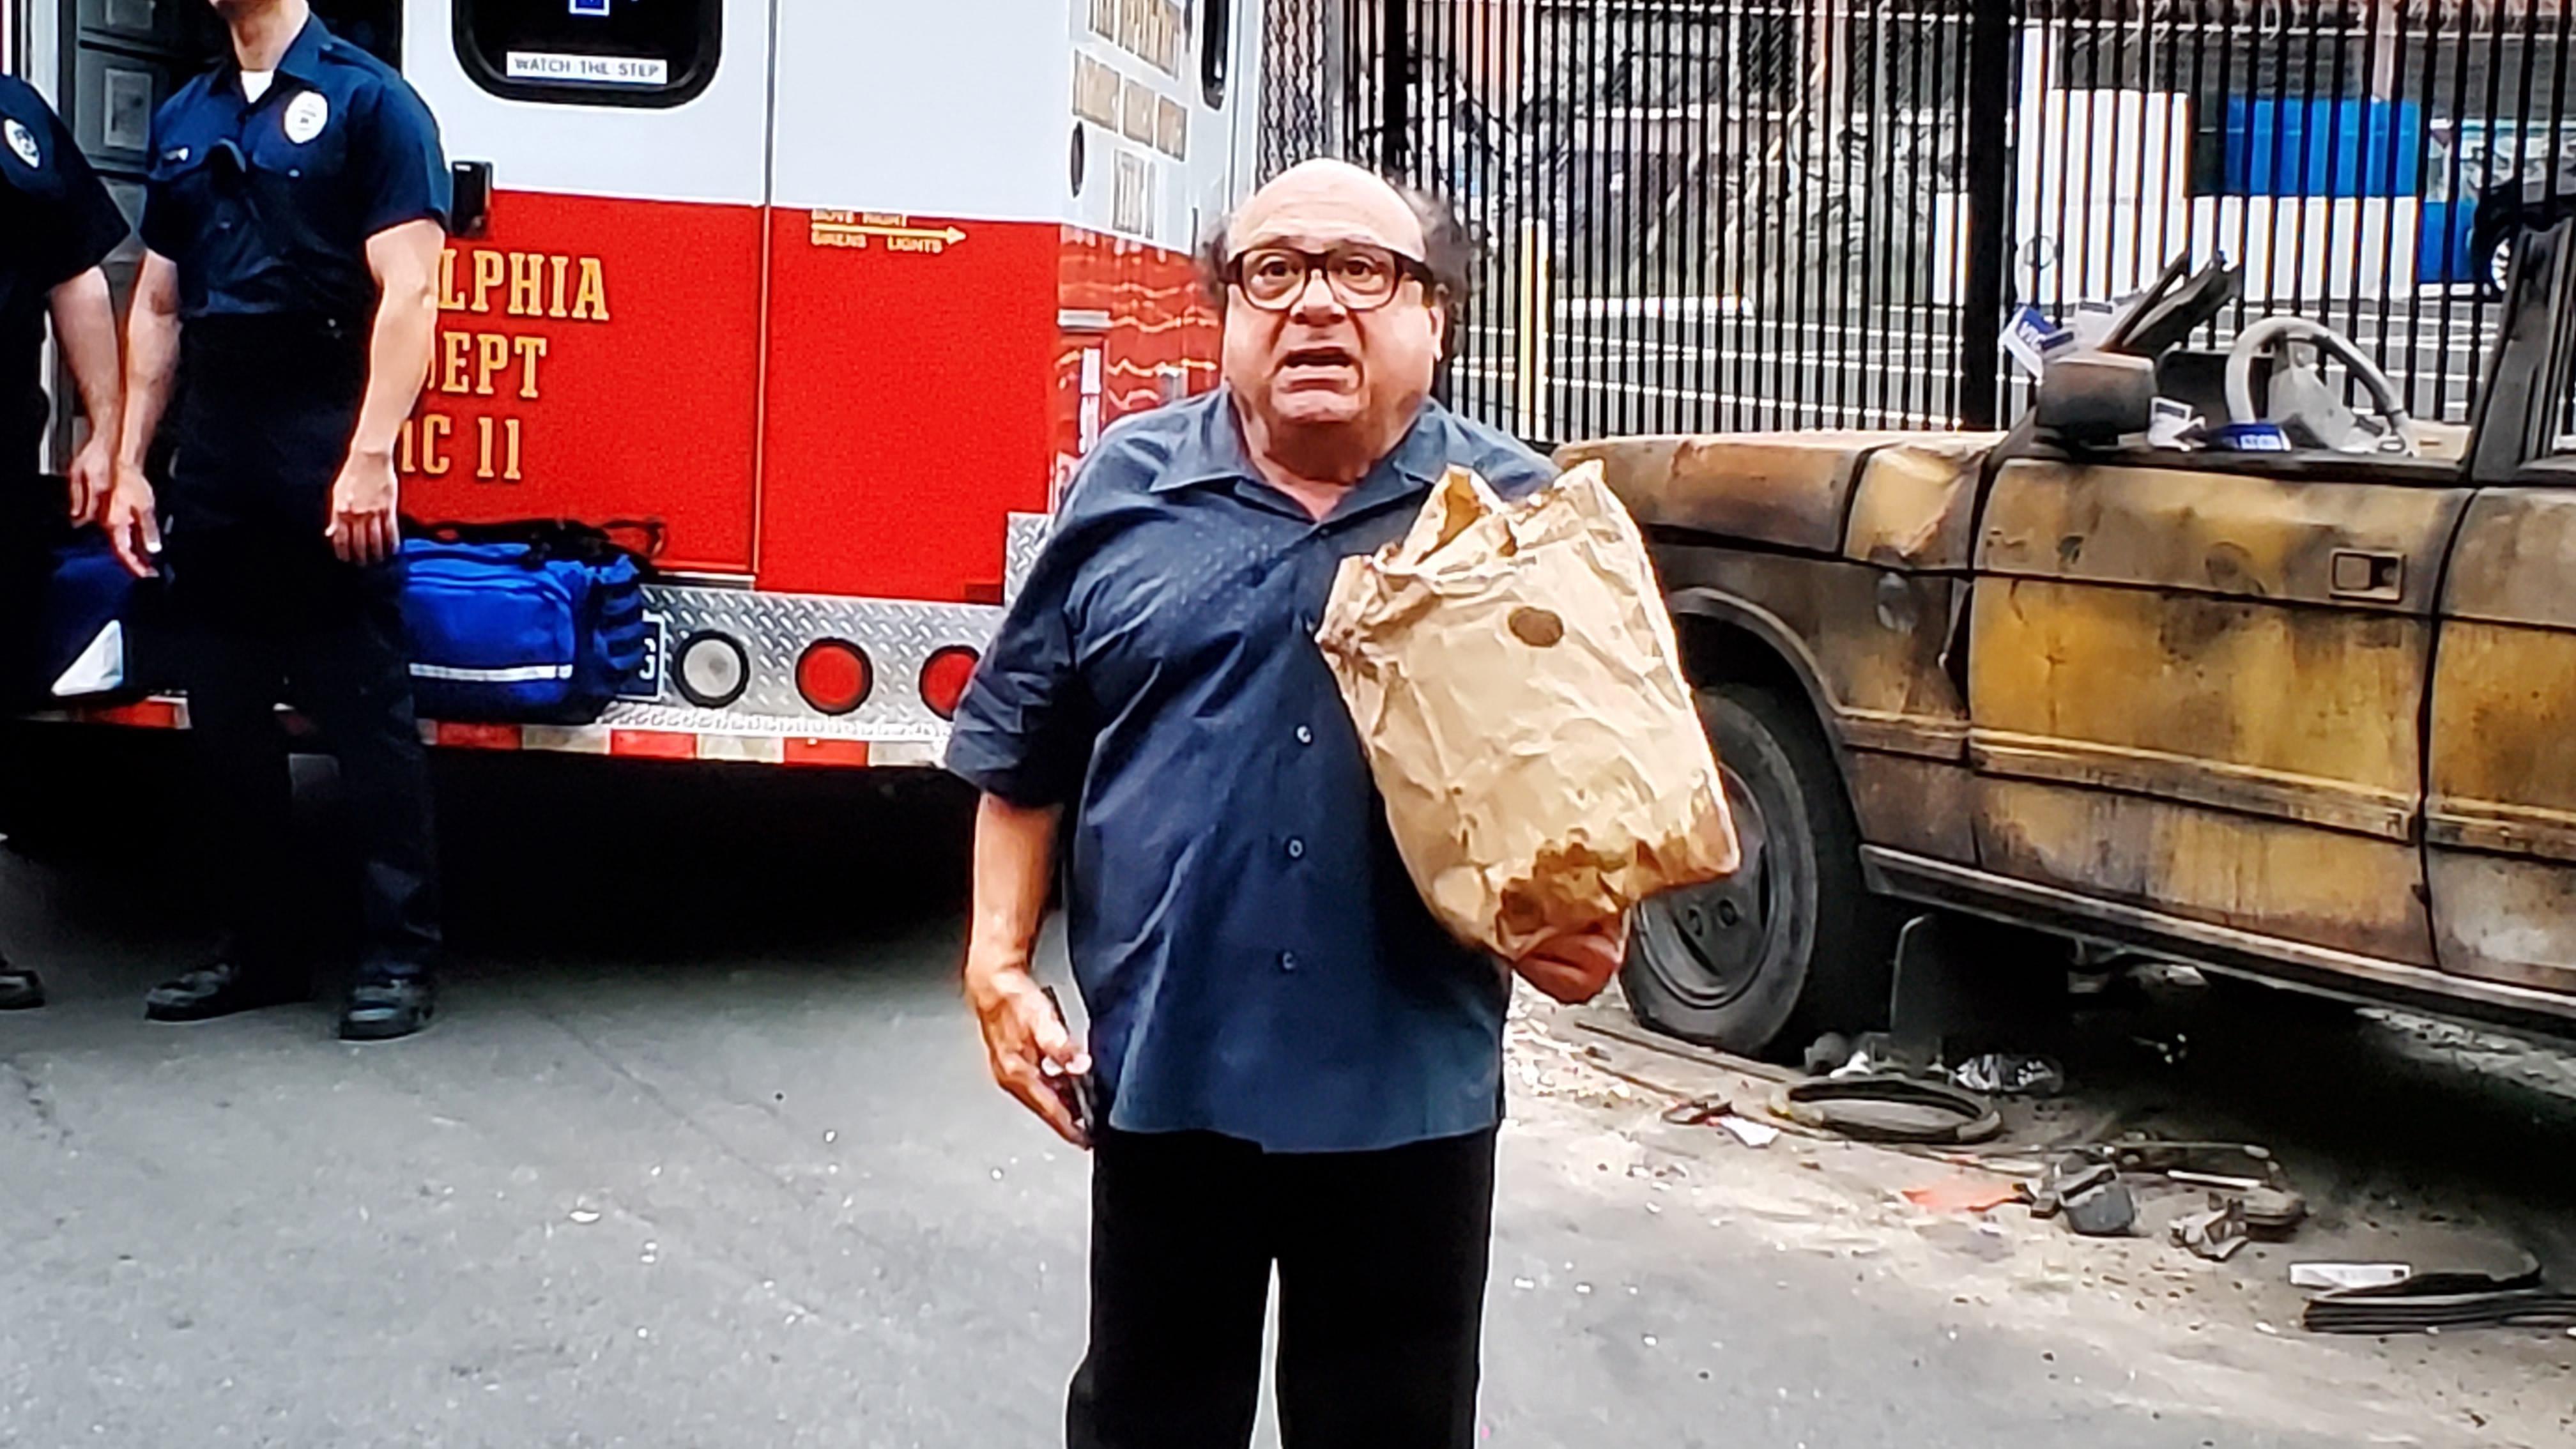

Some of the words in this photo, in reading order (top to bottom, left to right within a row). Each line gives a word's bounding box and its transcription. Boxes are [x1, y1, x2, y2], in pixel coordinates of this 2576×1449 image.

[514, 57, 571, 72] WATCH
[579, 60, 610, 75] THE
[617, 63, 659, 77] STEP
[887, 236, 943, 253] LIGHTS
[427, 331, 547, 399] EPT
[476, 416, 522, 480] 11
